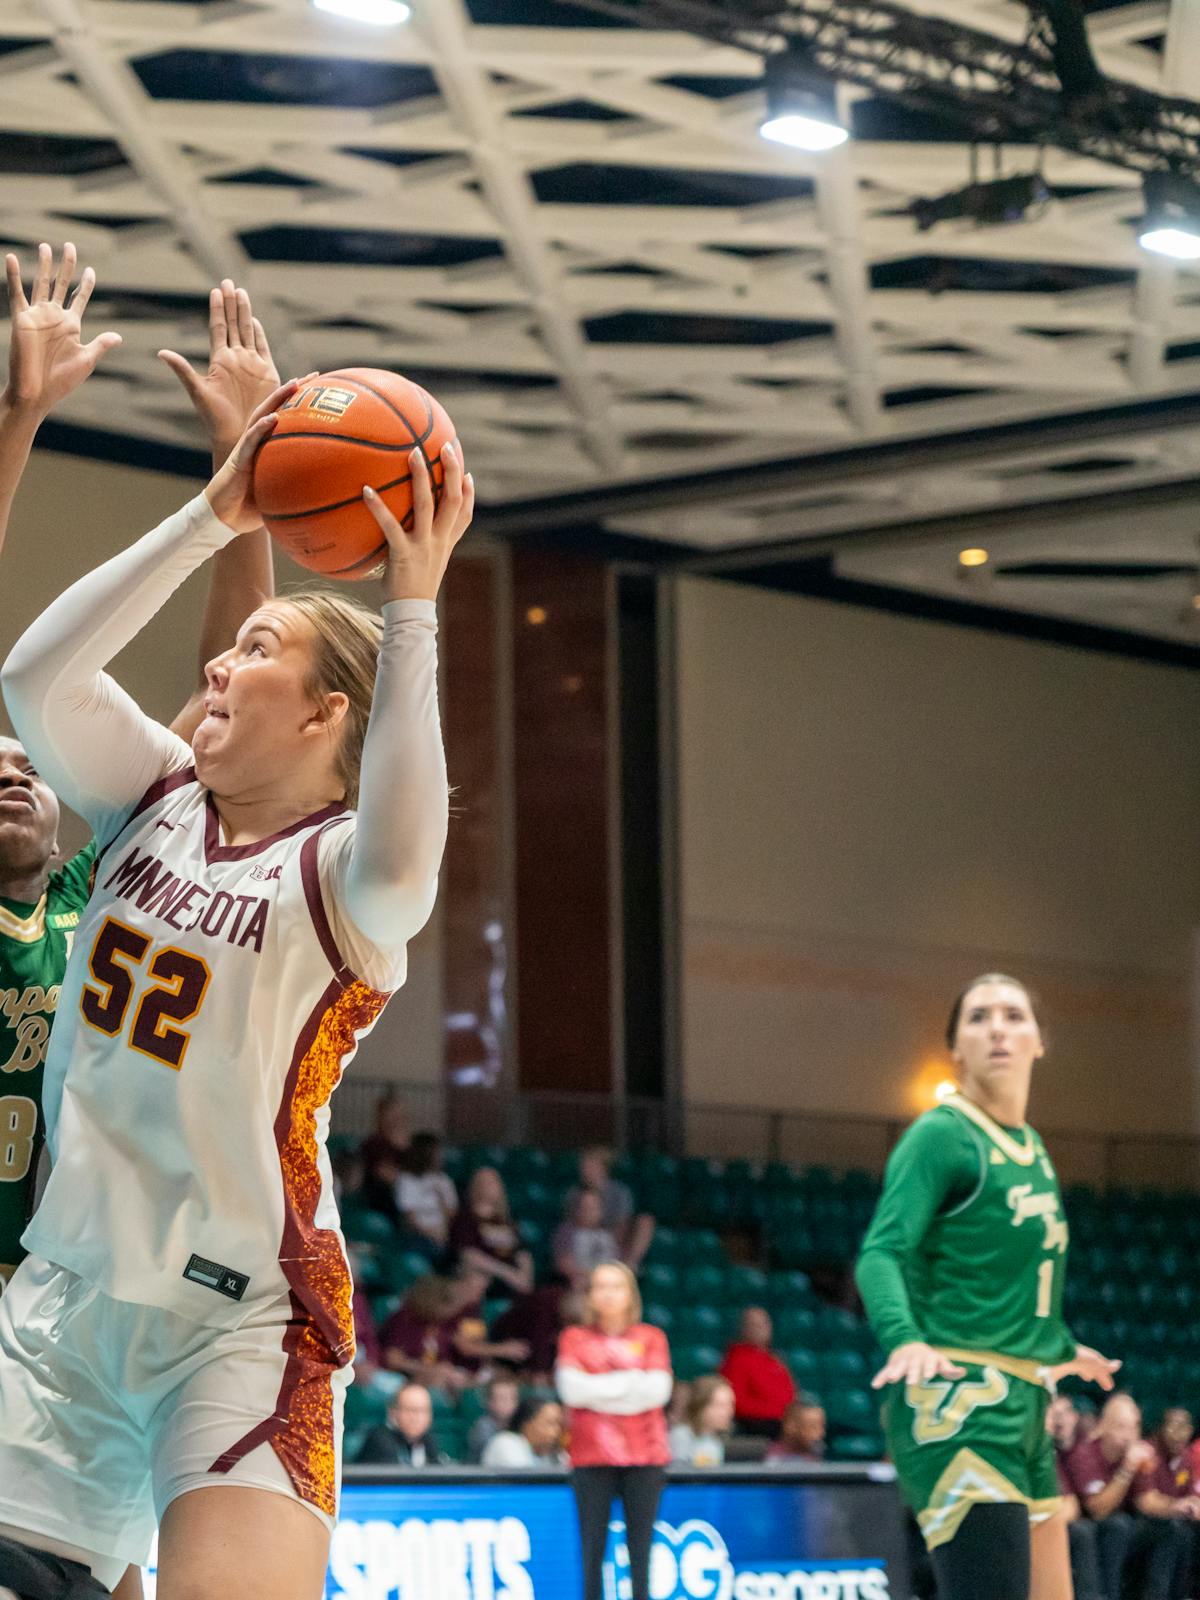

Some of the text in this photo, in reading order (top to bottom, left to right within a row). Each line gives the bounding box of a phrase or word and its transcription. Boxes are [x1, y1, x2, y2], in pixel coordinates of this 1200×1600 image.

[103, 847, 270, 953] MNNEOTA
[80, 915, 212, 1072] 52
[224, 1276, 238, 1292] XL
[1035, 1259, 1054, 1318] 1
[329, 1517, 533, 1600] SPORTS
